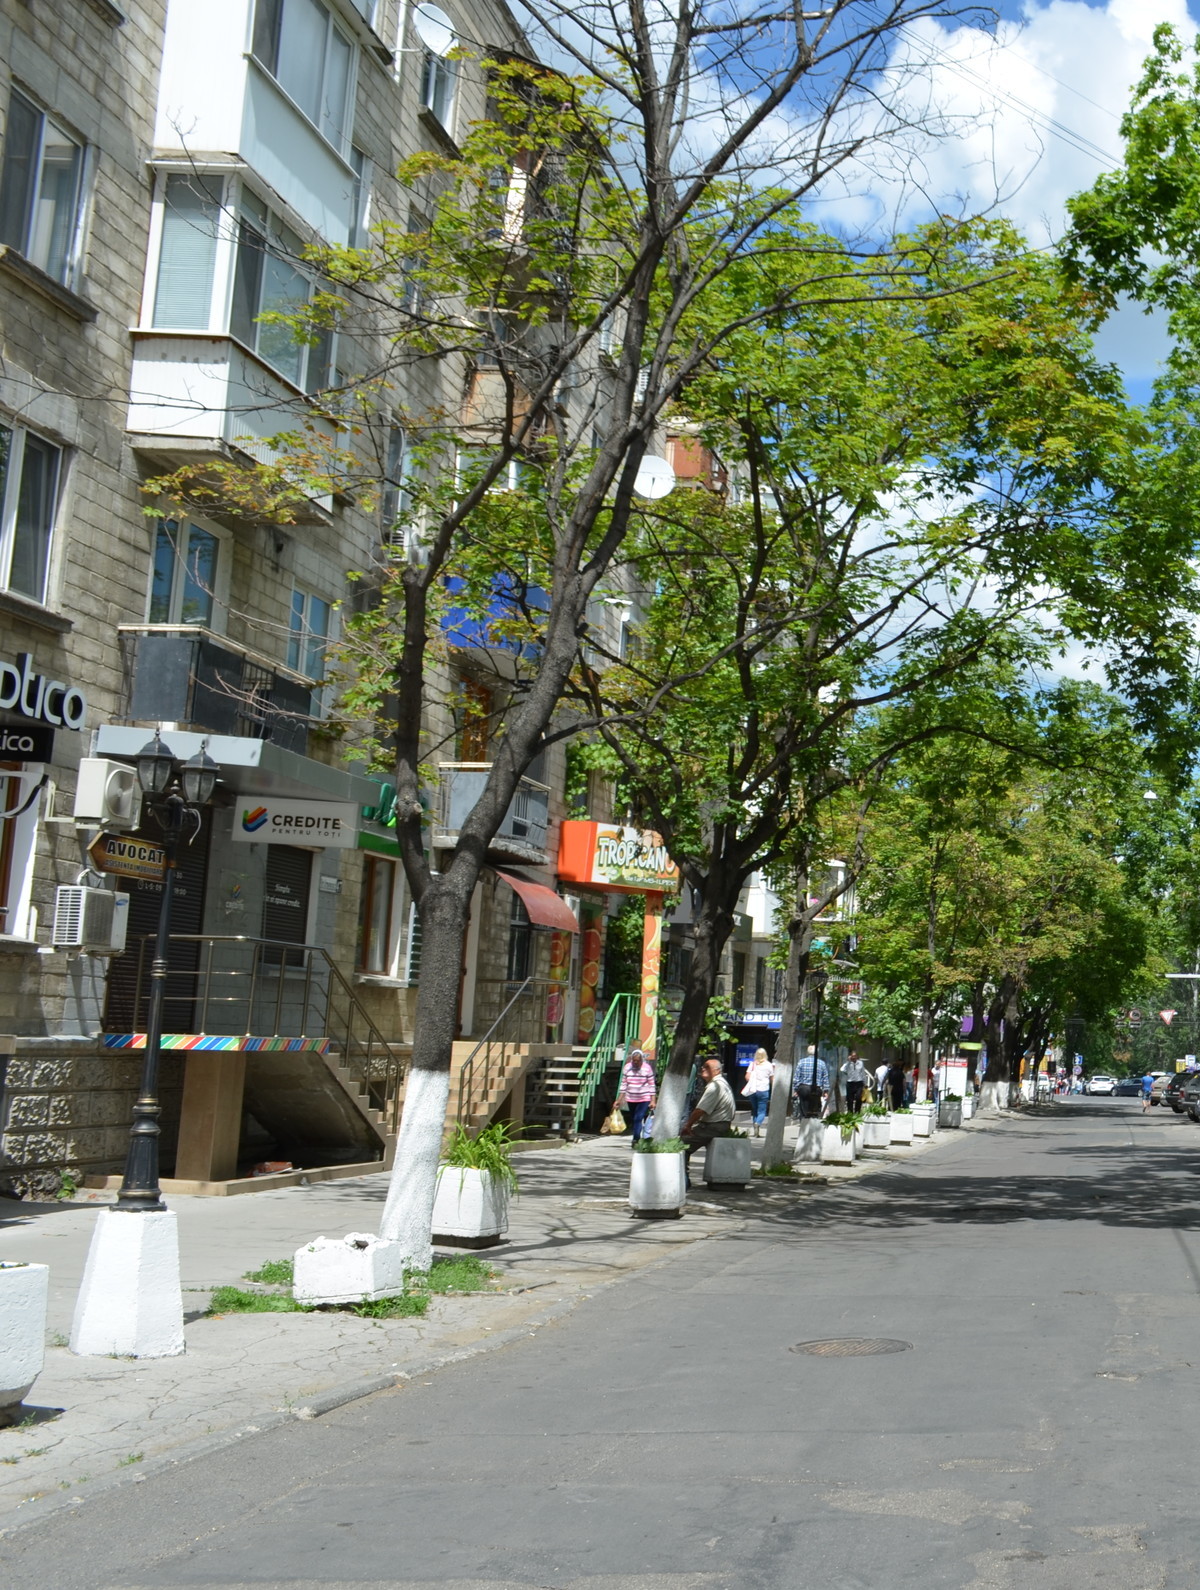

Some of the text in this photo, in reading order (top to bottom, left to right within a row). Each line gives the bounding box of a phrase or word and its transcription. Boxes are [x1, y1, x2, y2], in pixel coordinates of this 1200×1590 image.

[0, 729, 34, 752] ica
[272, 815, 341, 830] CREDITE
[272, 828, 311, 836] PENTRU
[106, 840, 166, 865] AVOCAT
